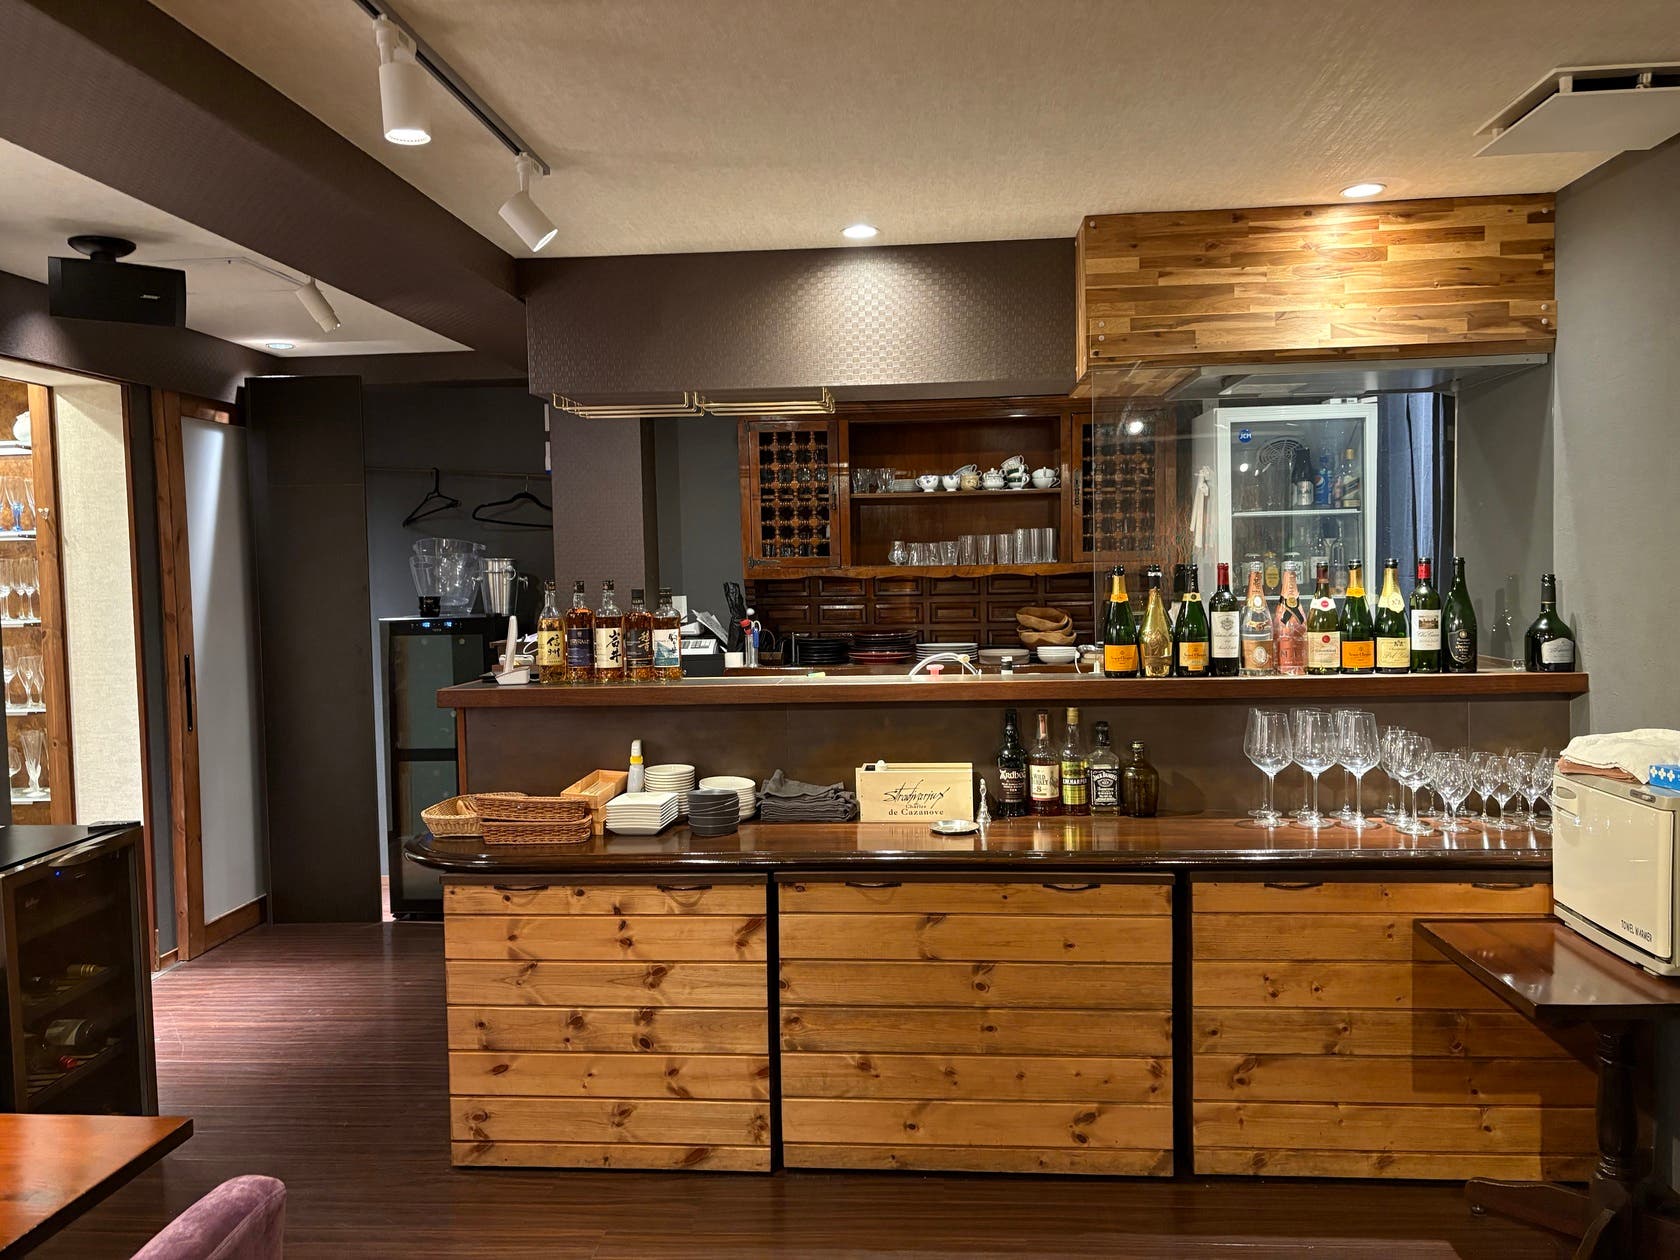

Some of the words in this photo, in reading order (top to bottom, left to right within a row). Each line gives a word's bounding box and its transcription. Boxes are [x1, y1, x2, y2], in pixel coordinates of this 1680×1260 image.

[1240, 432, 1251, 440] JCM
[547, 633, 561, 658] 信州
[606, 629, 621, 663] 岩井
[901, 808, 944, 816] Cazanove
[1621, 919, 1635, 935] TOWEL
